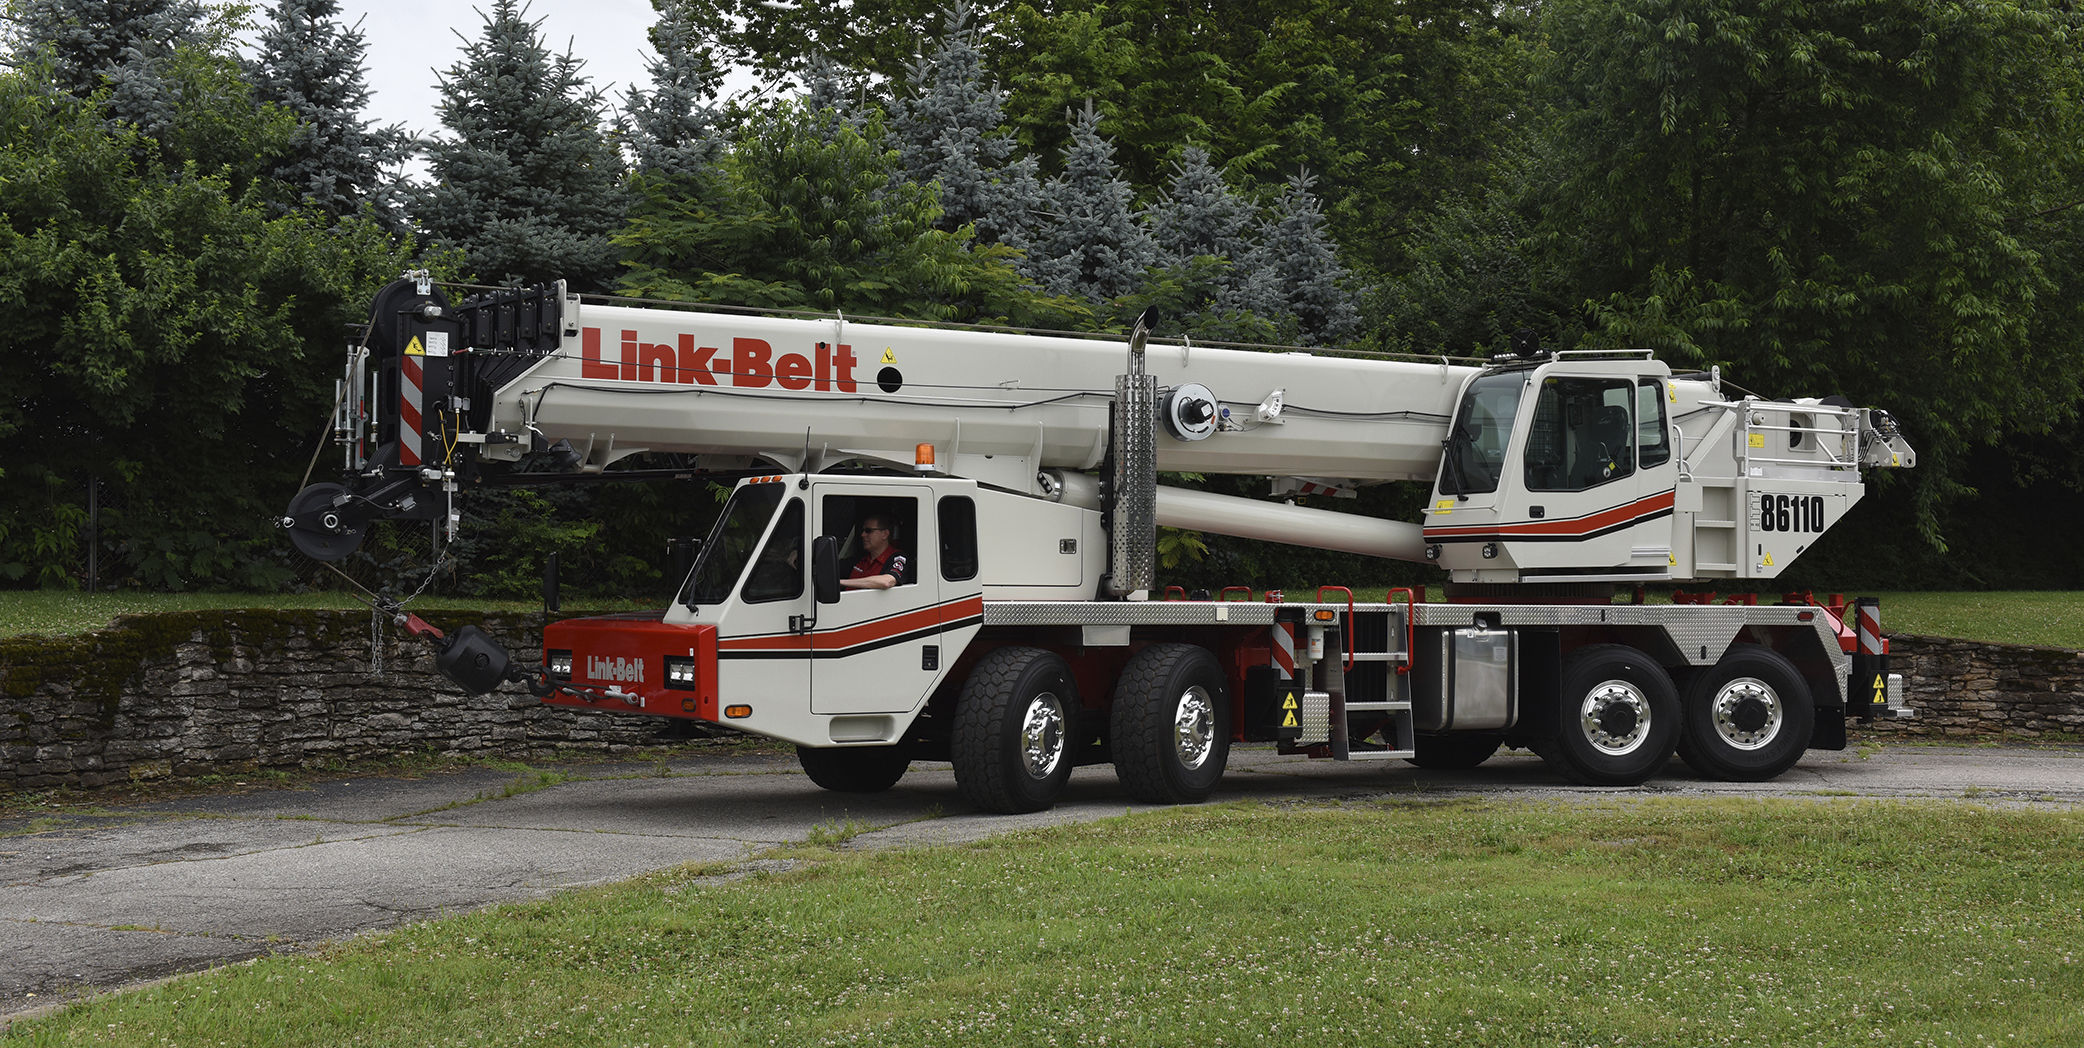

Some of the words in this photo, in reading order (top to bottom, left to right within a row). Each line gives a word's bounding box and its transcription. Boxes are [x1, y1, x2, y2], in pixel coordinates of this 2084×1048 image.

[582, 327, 857, 393] Link-Belt
[1761, 494, 1824, 533] 86110
[587, 655, 645, 683] Link-Belt
